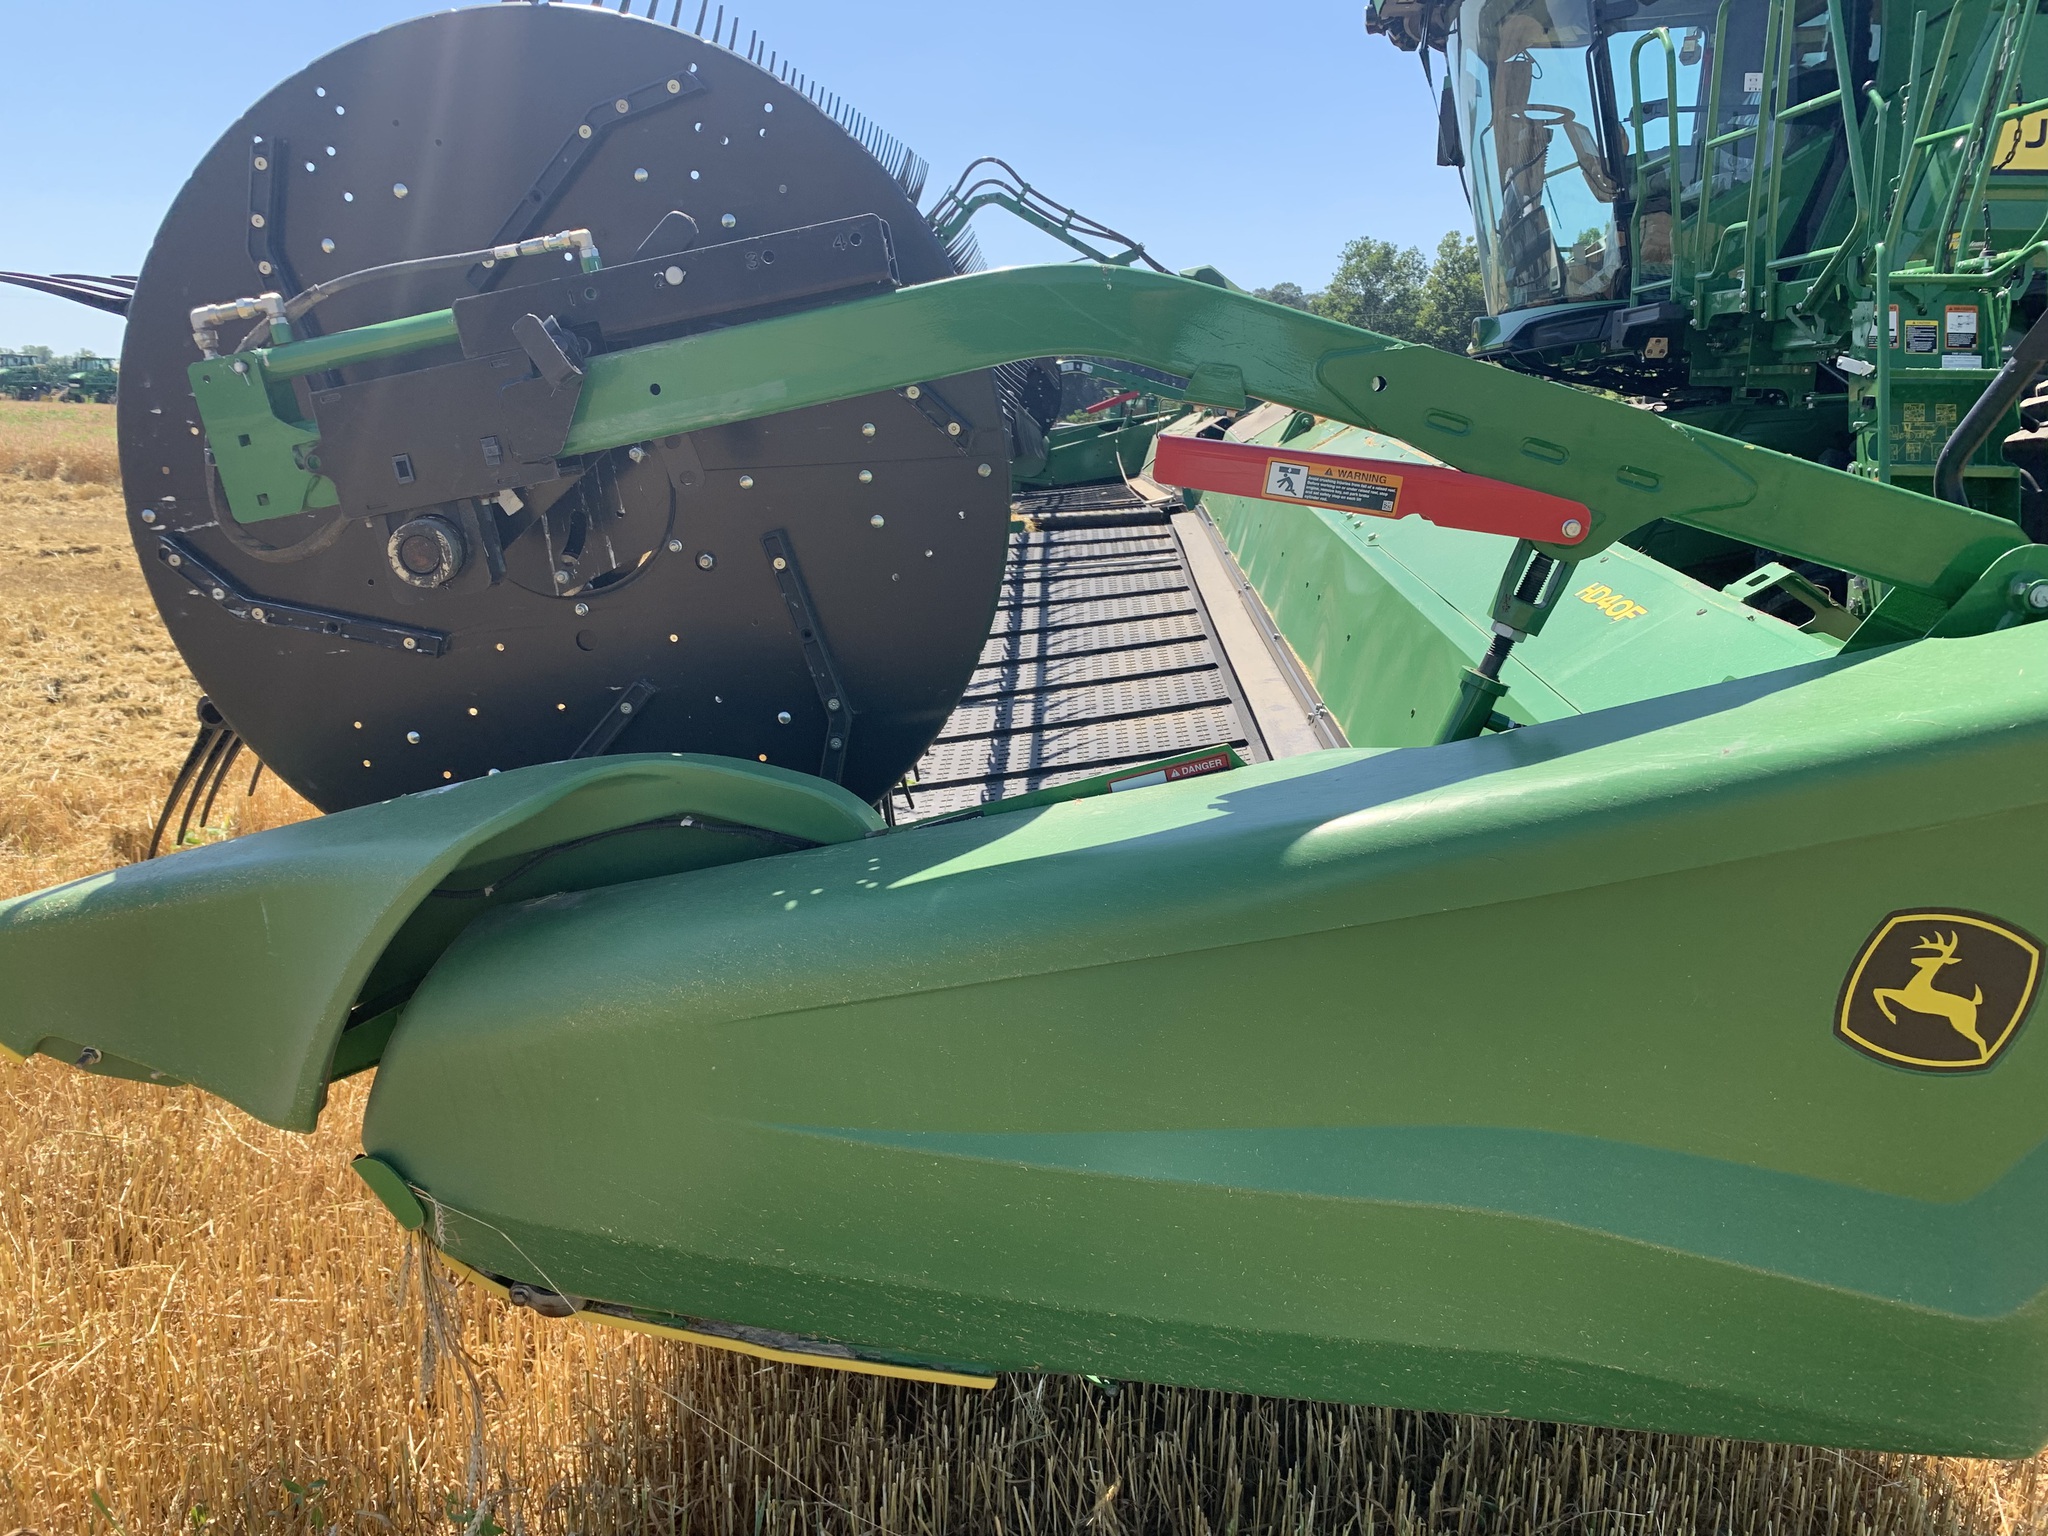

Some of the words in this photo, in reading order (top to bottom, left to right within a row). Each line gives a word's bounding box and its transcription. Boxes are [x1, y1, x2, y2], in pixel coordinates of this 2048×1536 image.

[745, 251, 758, 270] 3
[832, 233, 847, 251] 4
[1338, 469, 1387, 484] WARNING
[1574, 582, 1648, 621] HD40F
[1181, 759, 1223, 775] DANGER
